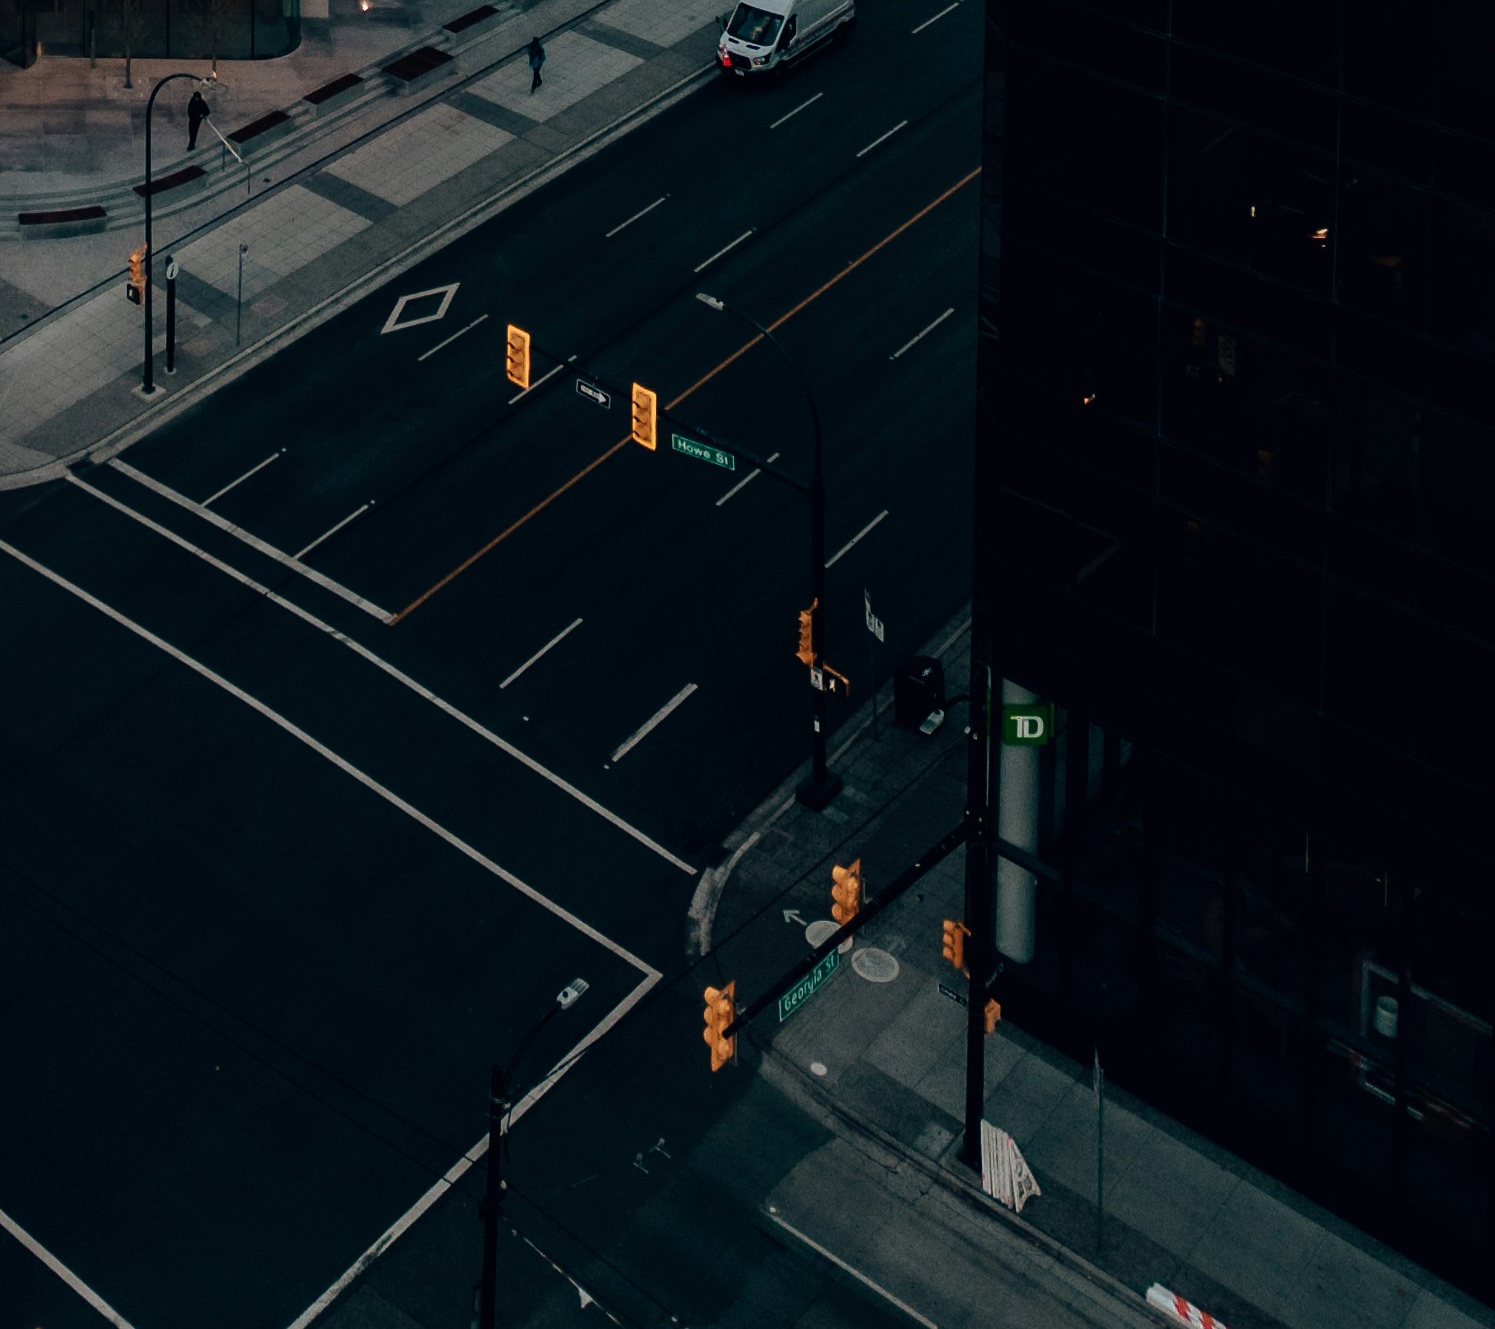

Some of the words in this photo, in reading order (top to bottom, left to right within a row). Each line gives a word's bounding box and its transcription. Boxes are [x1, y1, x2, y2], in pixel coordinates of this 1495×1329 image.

[677, 439, 711, 460] Howe
[716, 453, 729, 466] St
[1010, 715, 1044, 738] TD
[784, 969, 822, 1012] Georgia
[825, 954, 835, 973] St
